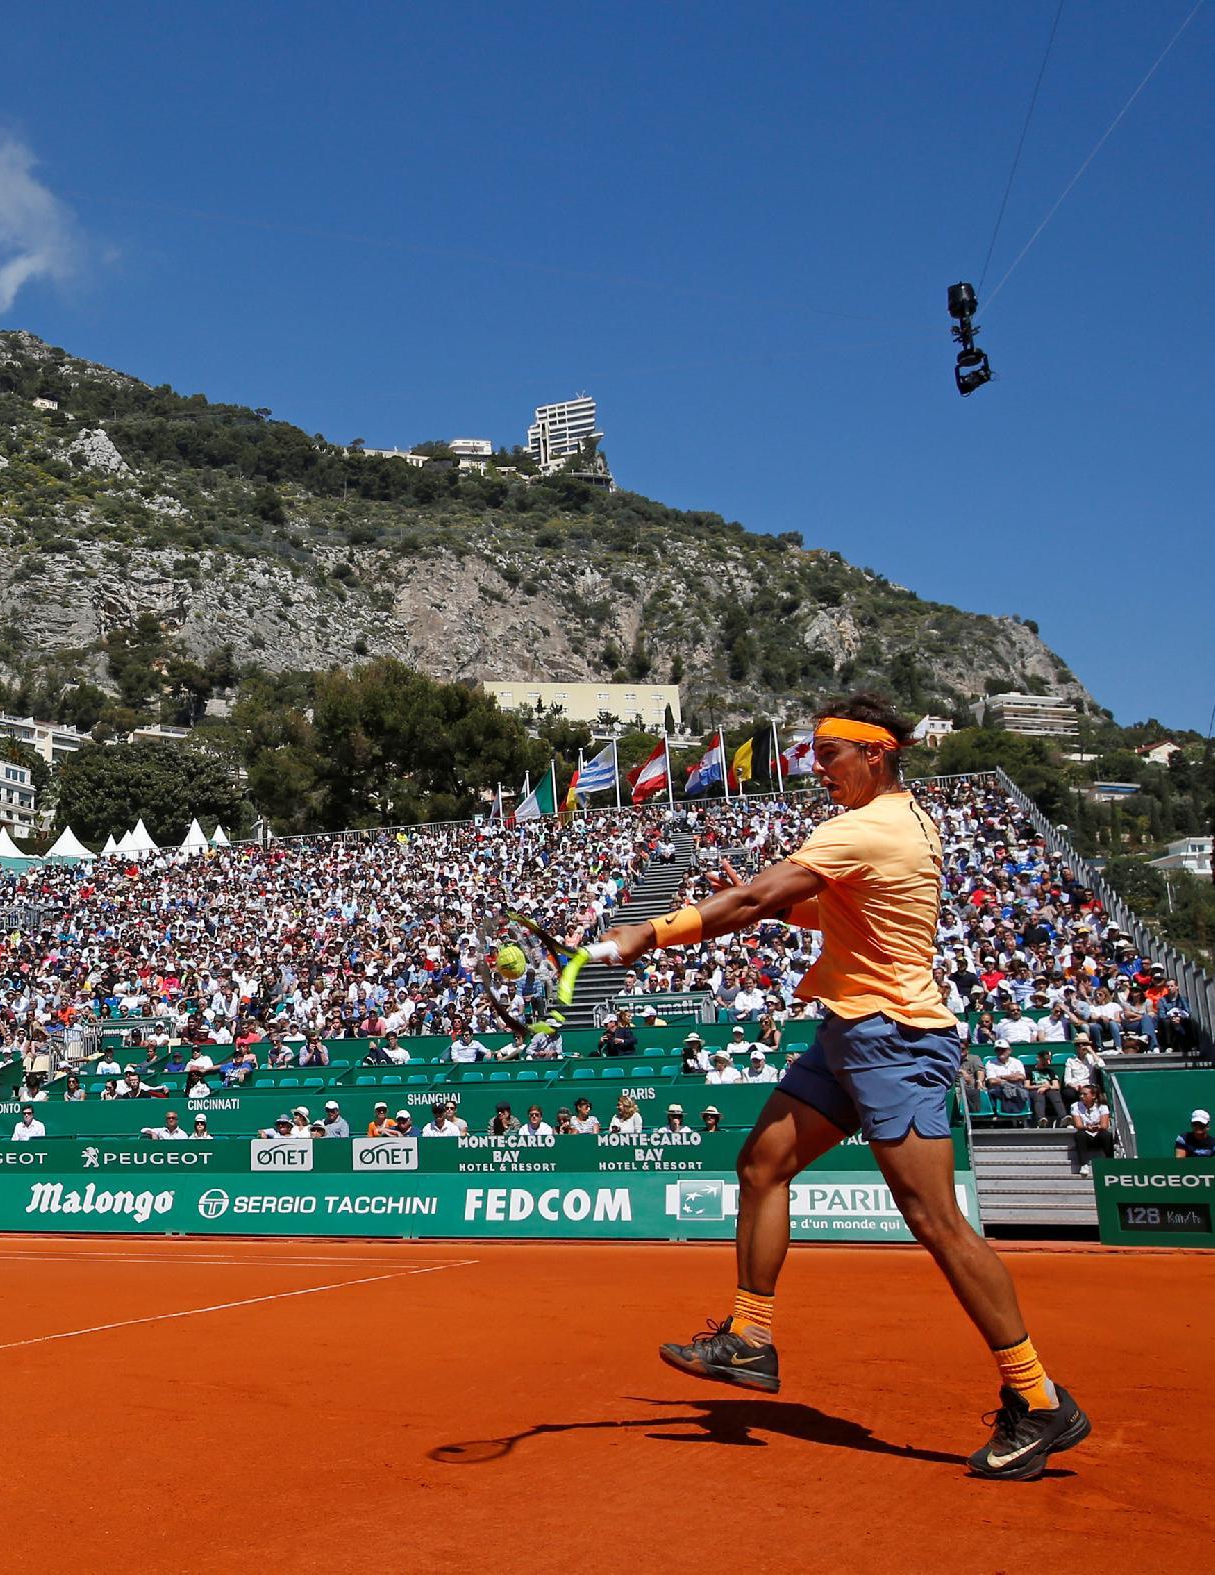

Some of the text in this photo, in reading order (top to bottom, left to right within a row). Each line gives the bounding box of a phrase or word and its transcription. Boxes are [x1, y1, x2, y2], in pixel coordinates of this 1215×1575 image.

[187, 1098, 240, 1111] CINCINNATI
[407, 1093, 461, 1106] SHANGHAI
[457, 1135, 556, 1148] MONTE-CARLO
[597, 1132, 702, 1146] MONTE-CARLO
[103, 1152, 213, 1165] PEUGEOT
[492, 1150, 520, 1163] BAY
[634, 1148, 664, 1161] BAY
[459, 1163, 557, 1172] HOTEL & RESORT
[599, 1162, 703, 1171] HOTEL & RESORT
[1104, 1174, 1215, 1188] PEUGEOT
[25, 1182, 173, 1224] Malongo
[233, 1196, 438, 1215] SERGIO TACCHINI
[464, 1188, 632, 1222] FEDCOM
[808, 1189, 899, 1211] PARI
[801, 1219, 829, 1229] d'un
[833, 1219, 876, 1229] monde
[880, 1219, 900, 1232] qui
